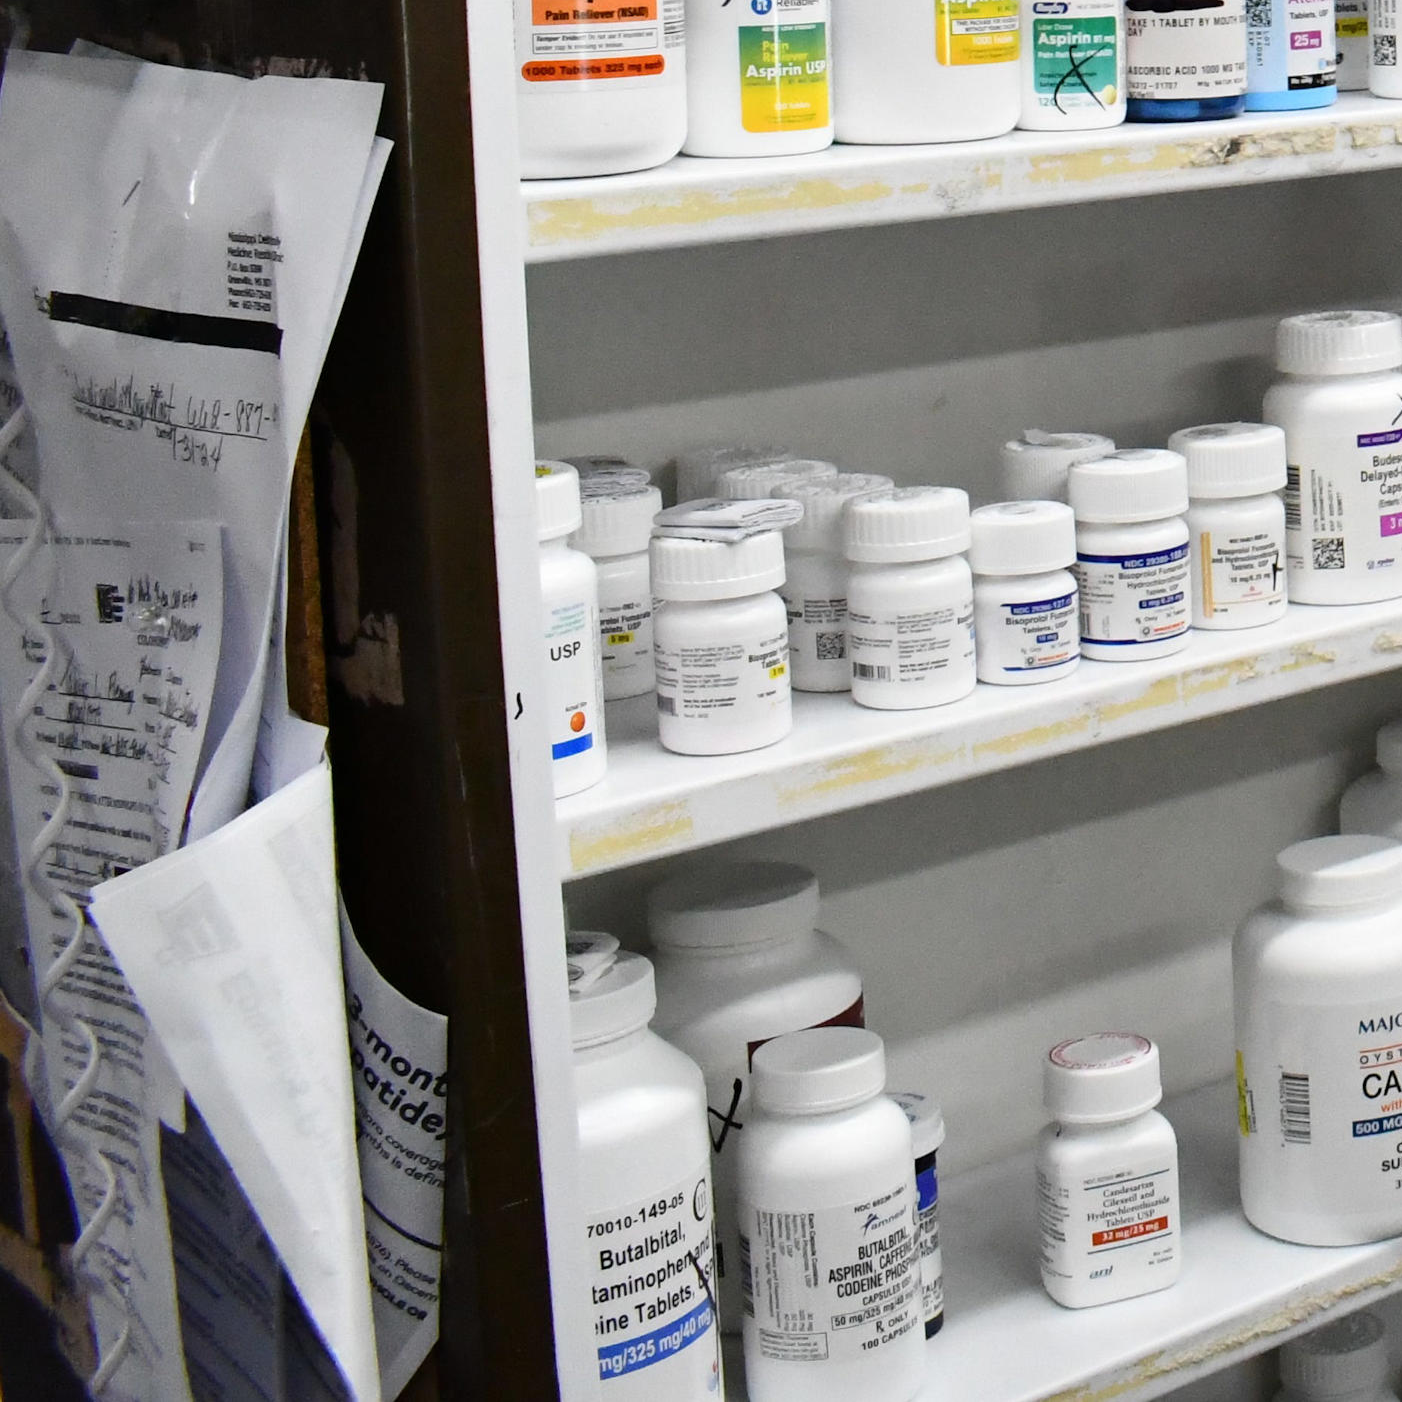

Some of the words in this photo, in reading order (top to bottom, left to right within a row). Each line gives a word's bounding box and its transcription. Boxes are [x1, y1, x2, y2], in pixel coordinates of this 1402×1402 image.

[545, 10, 569, 22] Pain
[573, 8, 614, 19] Reliever
[1127, 18, 1148, 27] TAKE
[1152, 19, 1156, 27] 1
[1159, 18, 1194, 27] TABLET
[1200, 18, 1209, 26] BY
[1038, 33, 1091, 45] Aspirin
[1127, 28, 1143, 37] DAY
[1295, 35, 1309, 46] 25
[1310, 38, 1320, 46] mg
[560, 64, 601, 75] Tablets
[605, 63, 624, 72] 325
[628, 62, 642, 73] mg
[746, 63, 802, 80] Aspirin
[1128, 66, 1172, 75] ASCORBIC
[1175, 66, 1197, 75] ACID
[1390, 518, 1396, 529] 3
[1005, 615, 1047, 626] Bisoprolol
[551, 641, 581, 661] USP
[1355, 1122, 1380, 1134] 500
[1103, 1182, 1154, 1197] Candesartan
[1103, 1194, 1138, 1207] Cilexetil
[1141, 1190, 1154, 1200] and
[587, 1192, 684, 1238] 70010-149-05
[1106, 1215, 1134, 1227] Tablets
[1138, 1210, 1155, 1220] USP
[1102, 1232, 1113, 1241] 32
[1146, 1222, 1159, 1232] mg
[600, 1222, 686, 1270] Butalbital,
[694, 1231, 710, 1262] and
[829, 1264, 877, 1283] ASPIRIN,
[837, 1274, 883, 1298] CODEINE
[863, 1283, 900, 1306] CAPSULES
[635, 1285, 695, 1324] Tablets,
[835, 1317, 846, 1326] 50
[850, 1308, 881, 1324] mg/325
[888, 1312, 909, 1327] ONLY
[660, 1317, 696, 1351] mg/40
[697, 1308, 711, 1331] mg
[862, 1338, 879, 1350] 100
